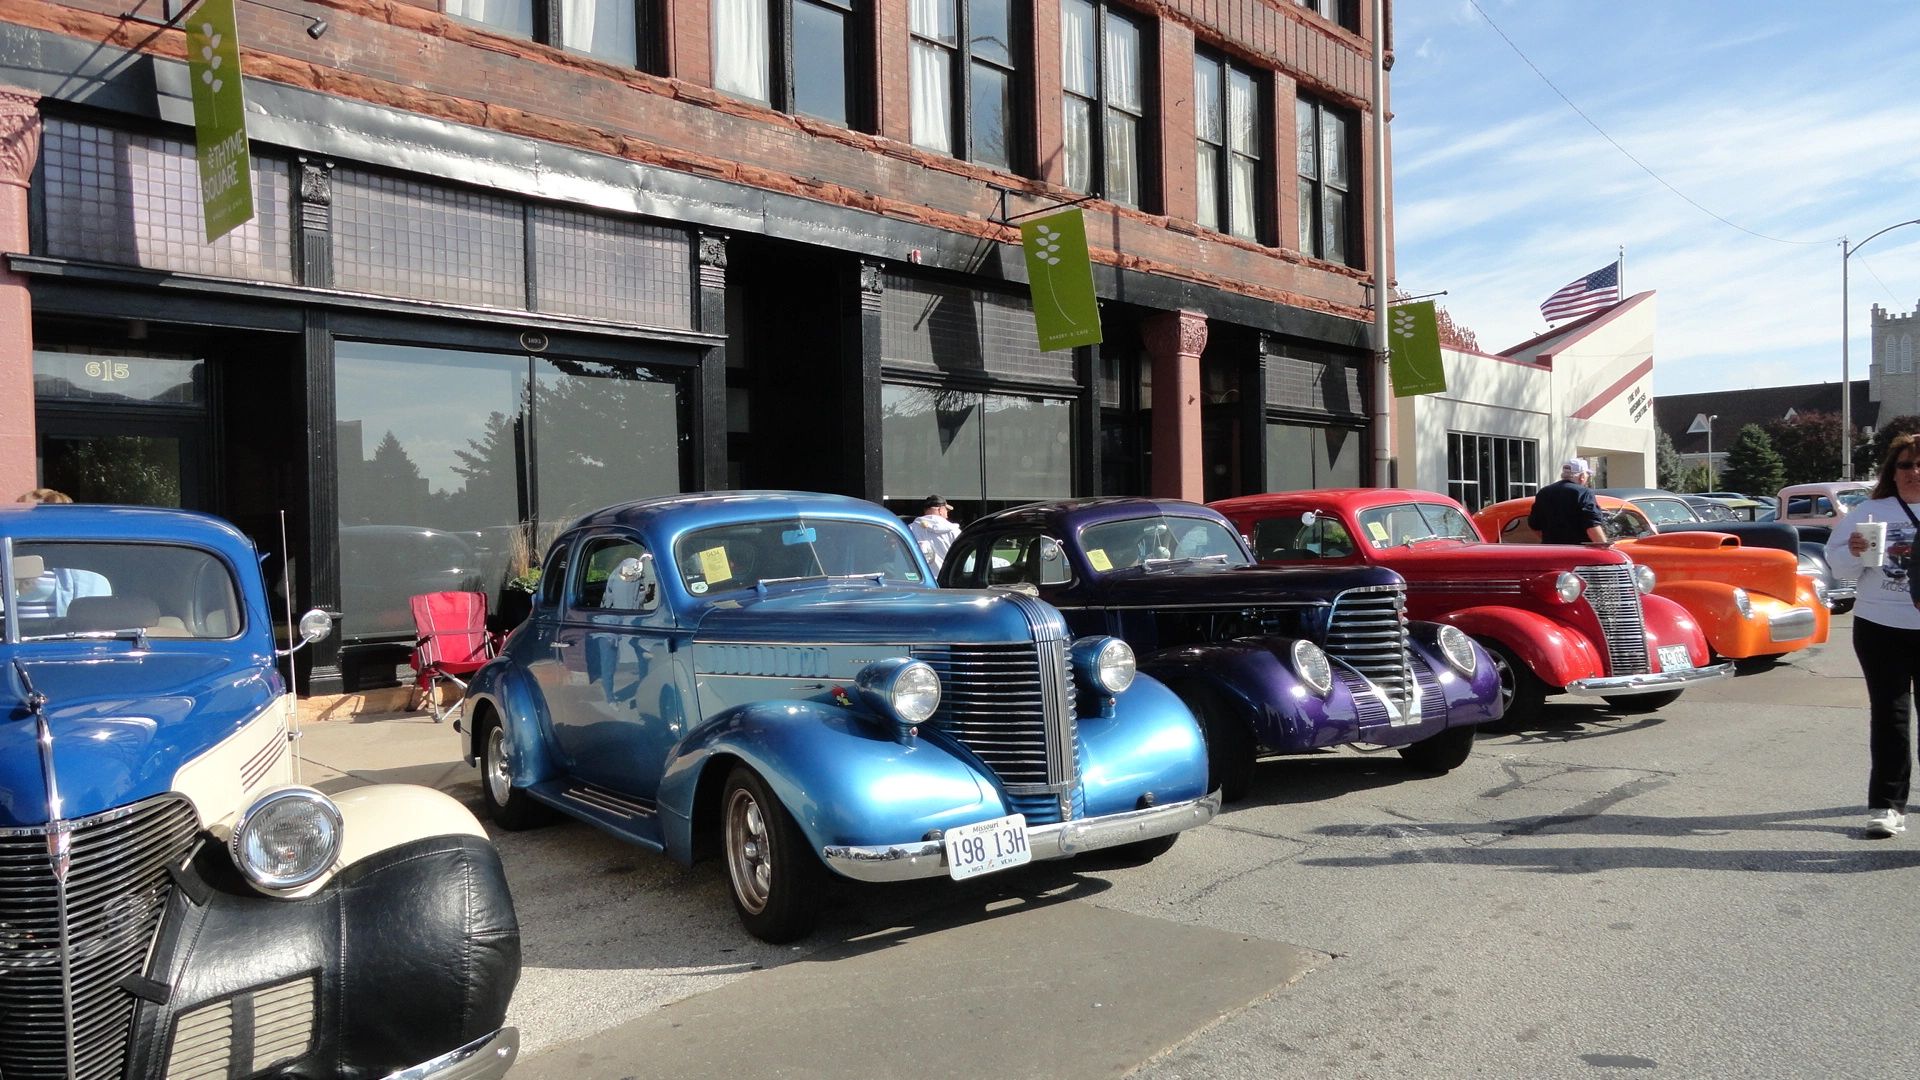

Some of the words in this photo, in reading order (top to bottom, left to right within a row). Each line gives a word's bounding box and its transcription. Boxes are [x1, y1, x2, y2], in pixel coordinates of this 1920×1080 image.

[213, 128, 245, 168] THYME
[203, 161, 239, 203] SQUARE
[85, 359, 130, 381] 615
[952, 837, 986, 867] 198
[993, 826, 1027, 858] 13H
[972, 822, 999, 833] Missouri
